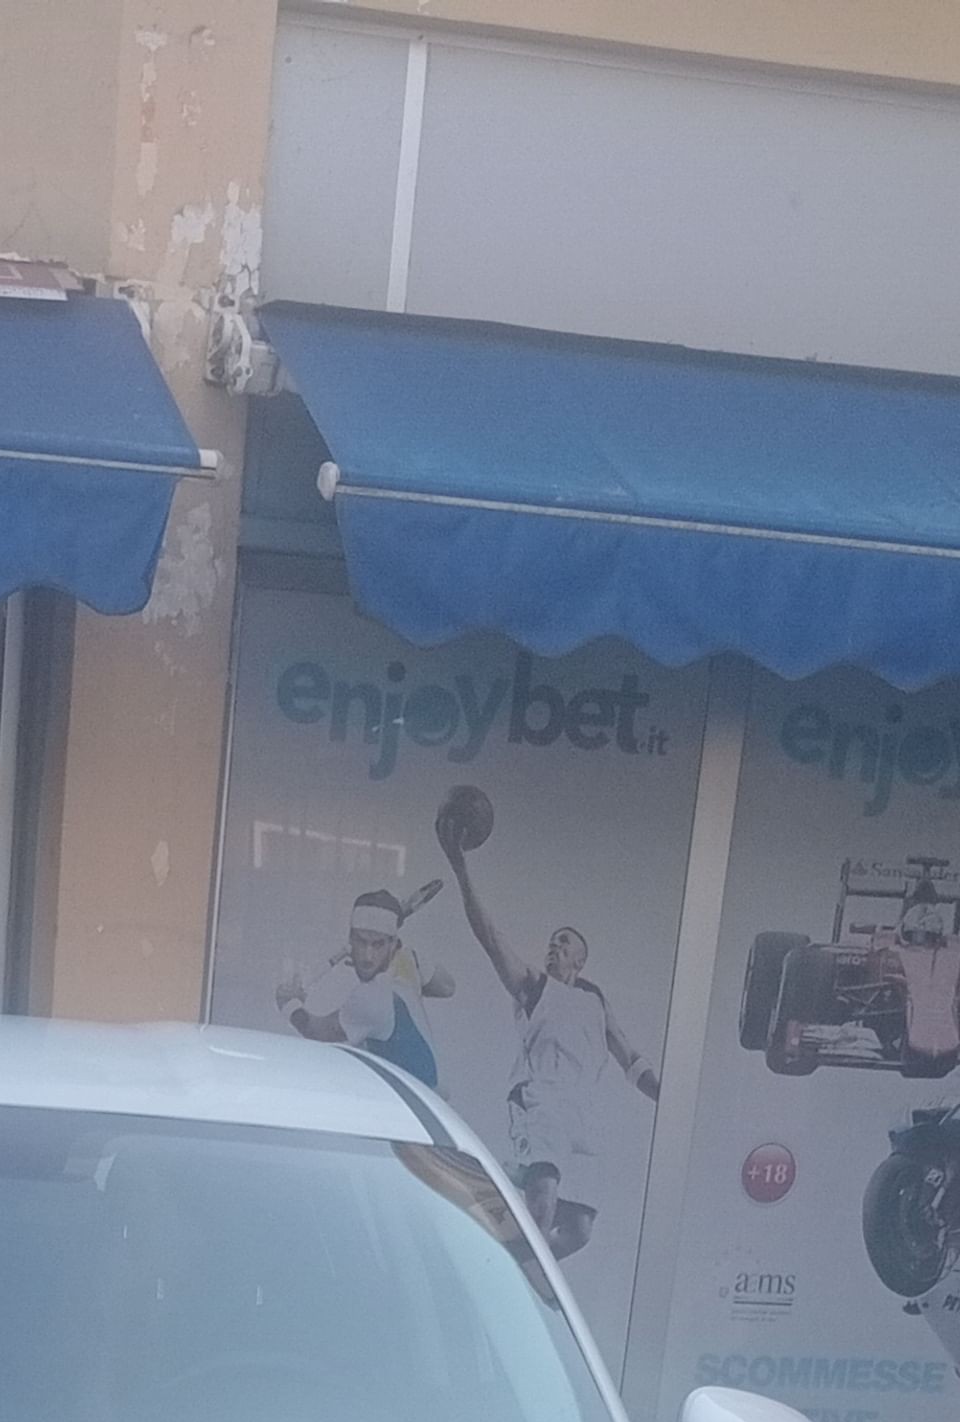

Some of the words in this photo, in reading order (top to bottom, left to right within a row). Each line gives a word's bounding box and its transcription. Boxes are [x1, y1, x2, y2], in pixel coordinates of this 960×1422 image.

[781, 702, 960, 819] enjo
[747, 1164, 787, 1185] +18
[694, 1353, 947, 1393] SCOMMESSE
